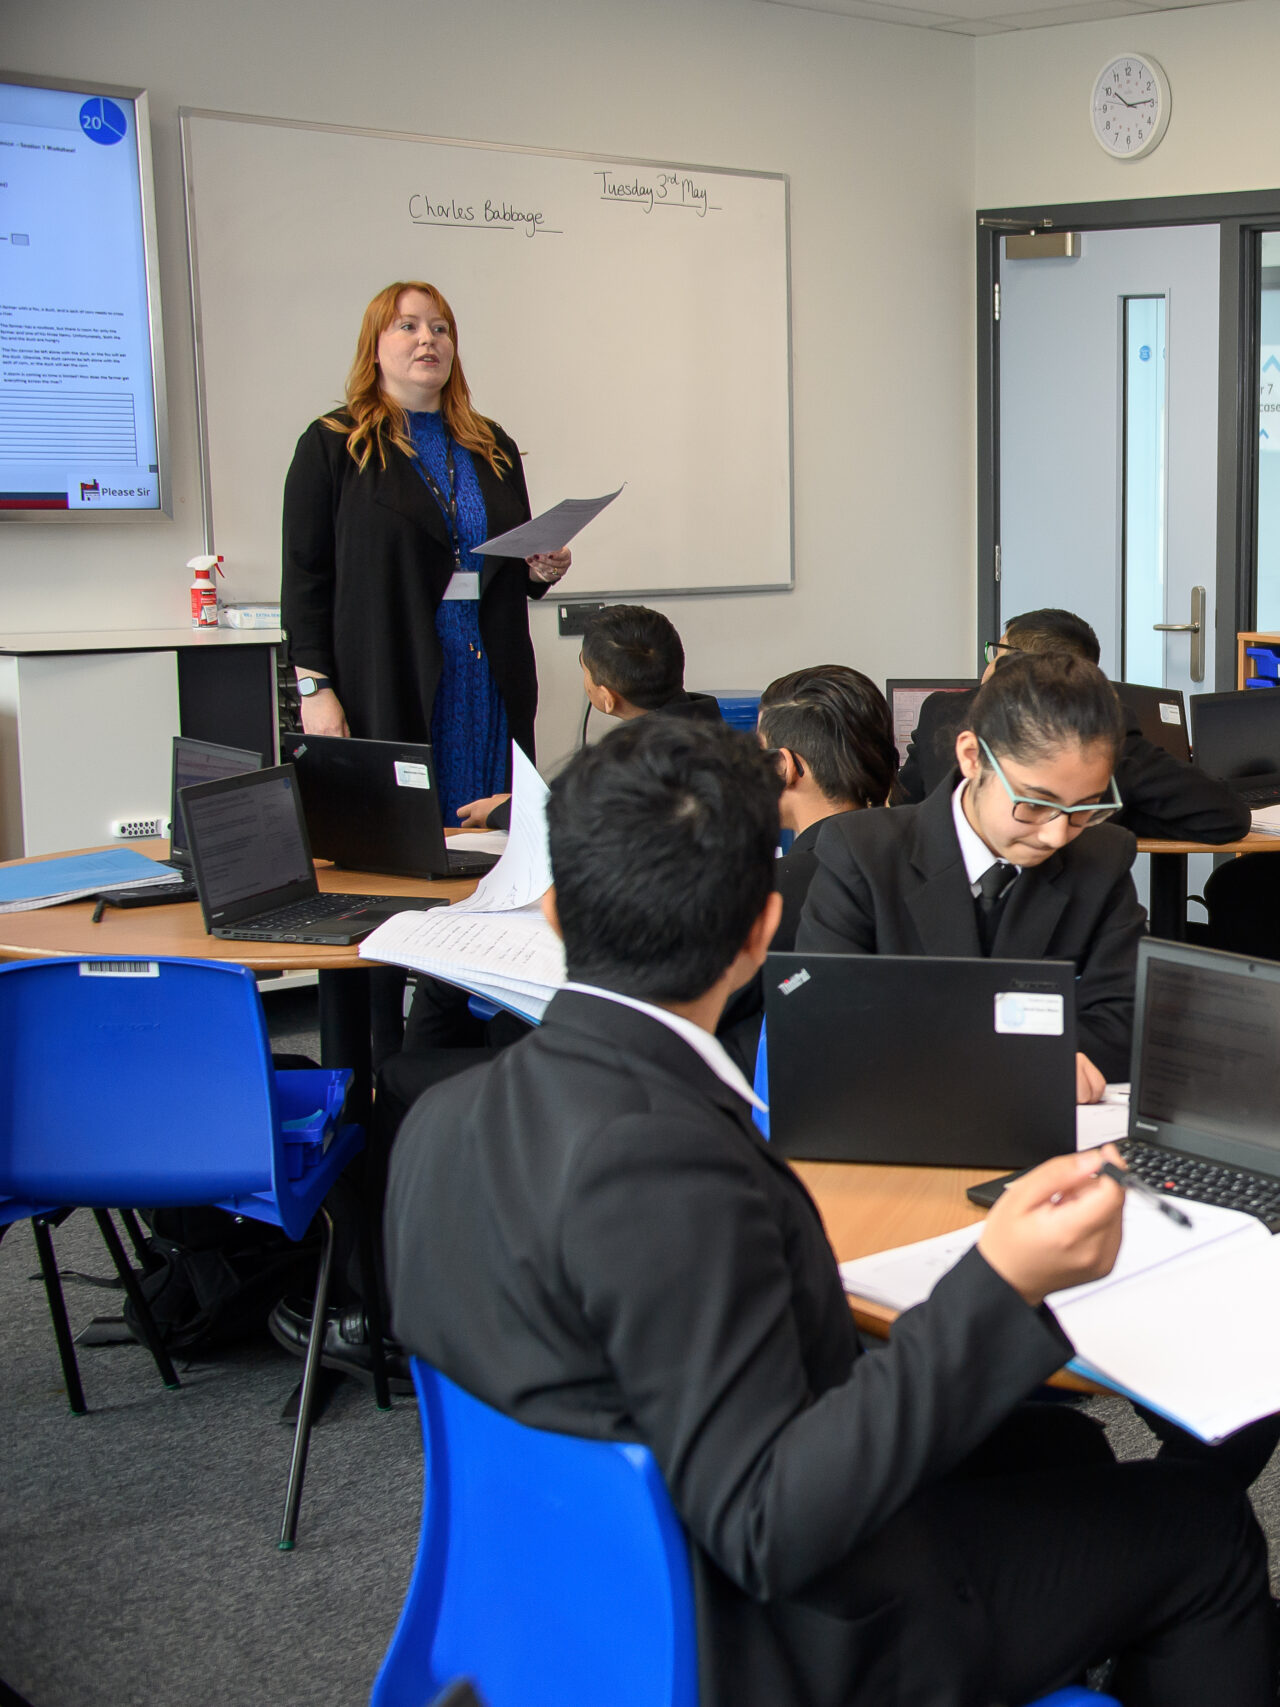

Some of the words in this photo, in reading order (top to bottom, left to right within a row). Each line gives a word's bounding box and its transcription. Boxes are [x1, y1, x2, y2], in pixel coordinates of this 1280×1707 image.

[83, 116, 102, 130] 20
[594, 172, 654, 213] Tuesday
[681, 178, 708, 217] May
[408, 194, 474, 220] Charles
[485, 200, 545, 238] Babbage
[1268, 384, 1273, 394] 7
[1260, 403, 1280, 412] case
[102, 487, 135, 497] Please
[138, 487, 150, 497] Sir
